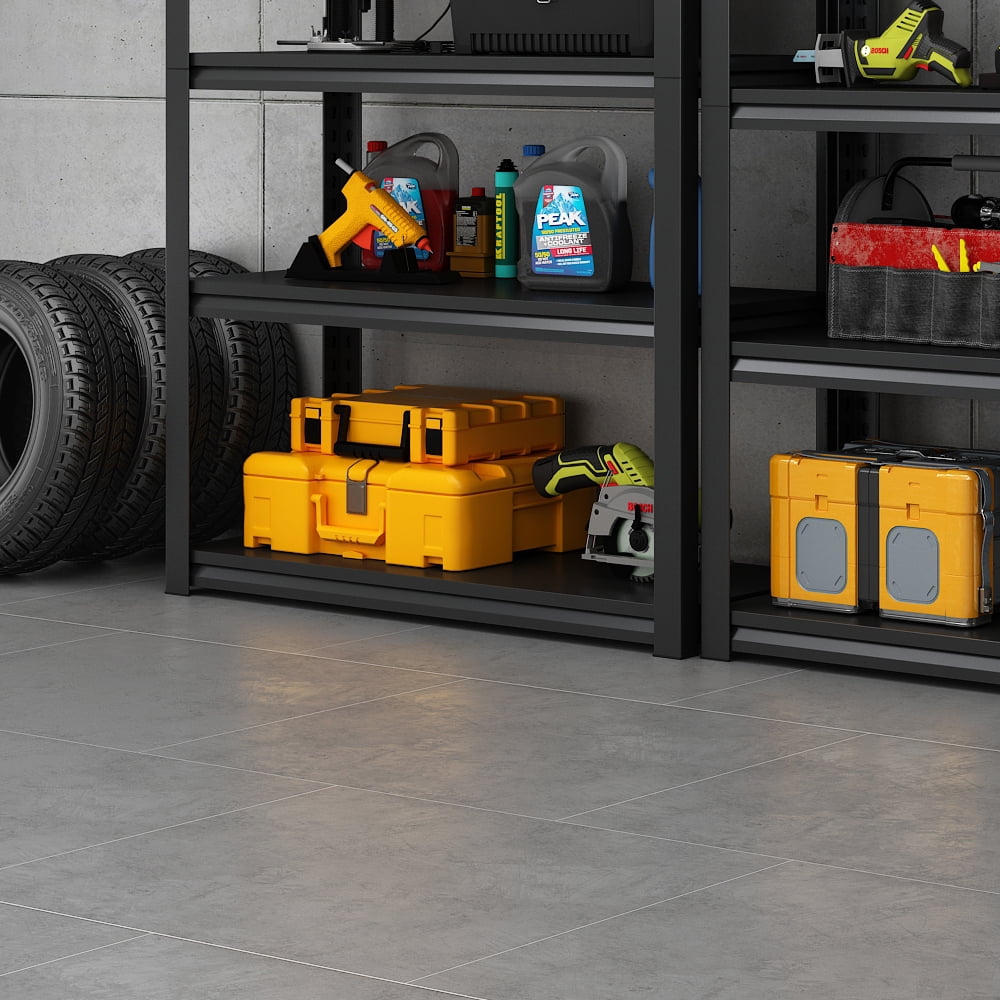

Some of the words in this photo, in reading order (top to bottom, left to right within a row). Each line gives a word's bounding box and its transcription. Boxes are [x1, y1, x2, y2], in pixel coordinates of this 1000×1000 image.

[495, 193, 503, 259] KRAFTOOL
[537, 210, 586, 229] PEAK
[539, 233, 588, 241] ANTIFREEZE
